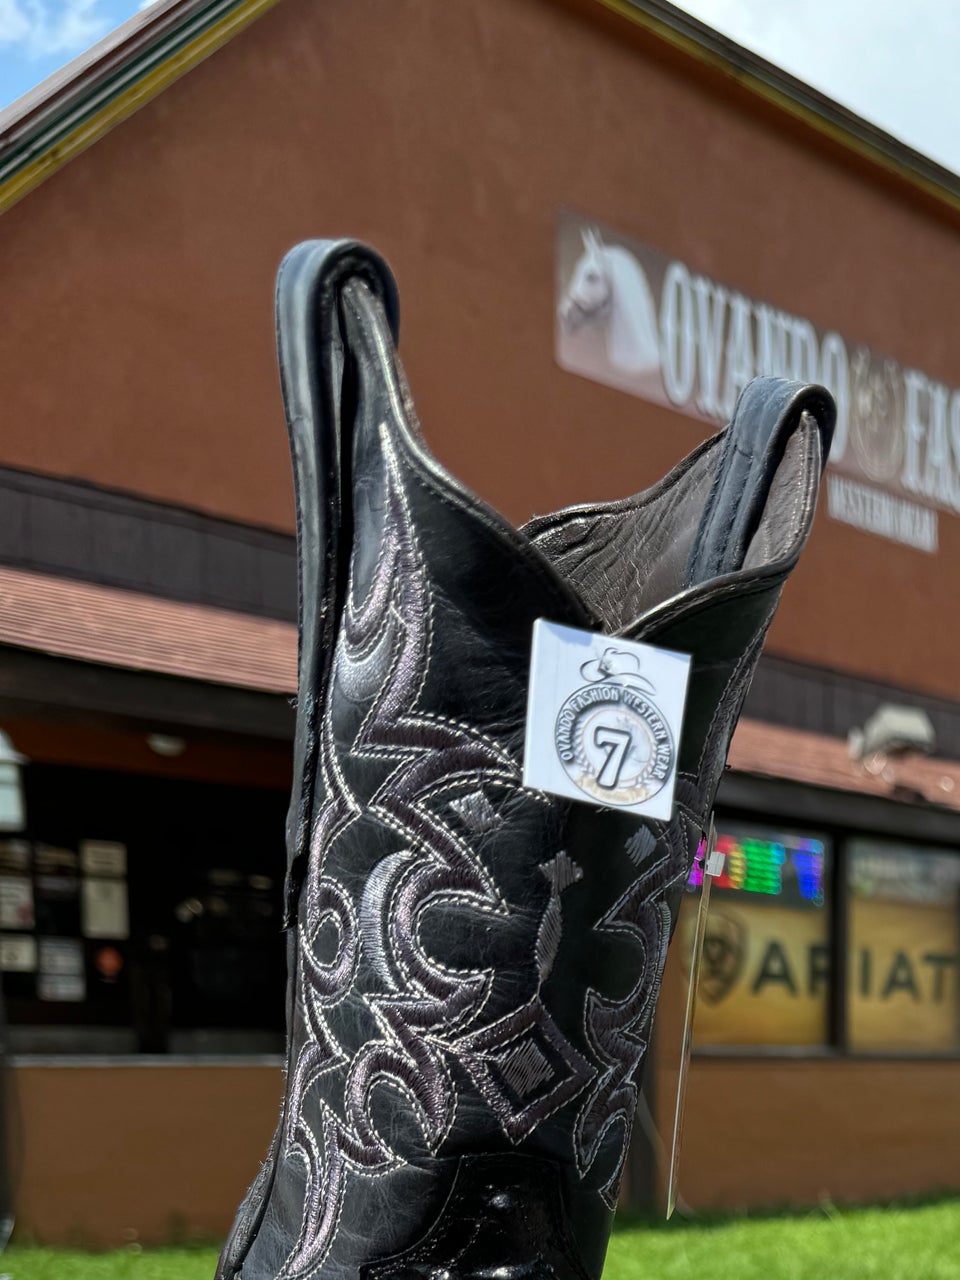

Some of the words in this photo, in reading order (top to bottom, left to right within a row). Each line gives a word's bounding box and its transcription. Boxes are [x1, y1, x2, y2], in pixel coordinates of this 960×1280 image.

[558, 708, 576, 762] OVANDO
[570, 686, 620, 713] FASHION
[623, 689, 668, 741] WESTERN
[651, 743, 672, 781] WEAR
[593, 725, 632, 791] 7
[752, 937, 957, 1006] ARIAT
